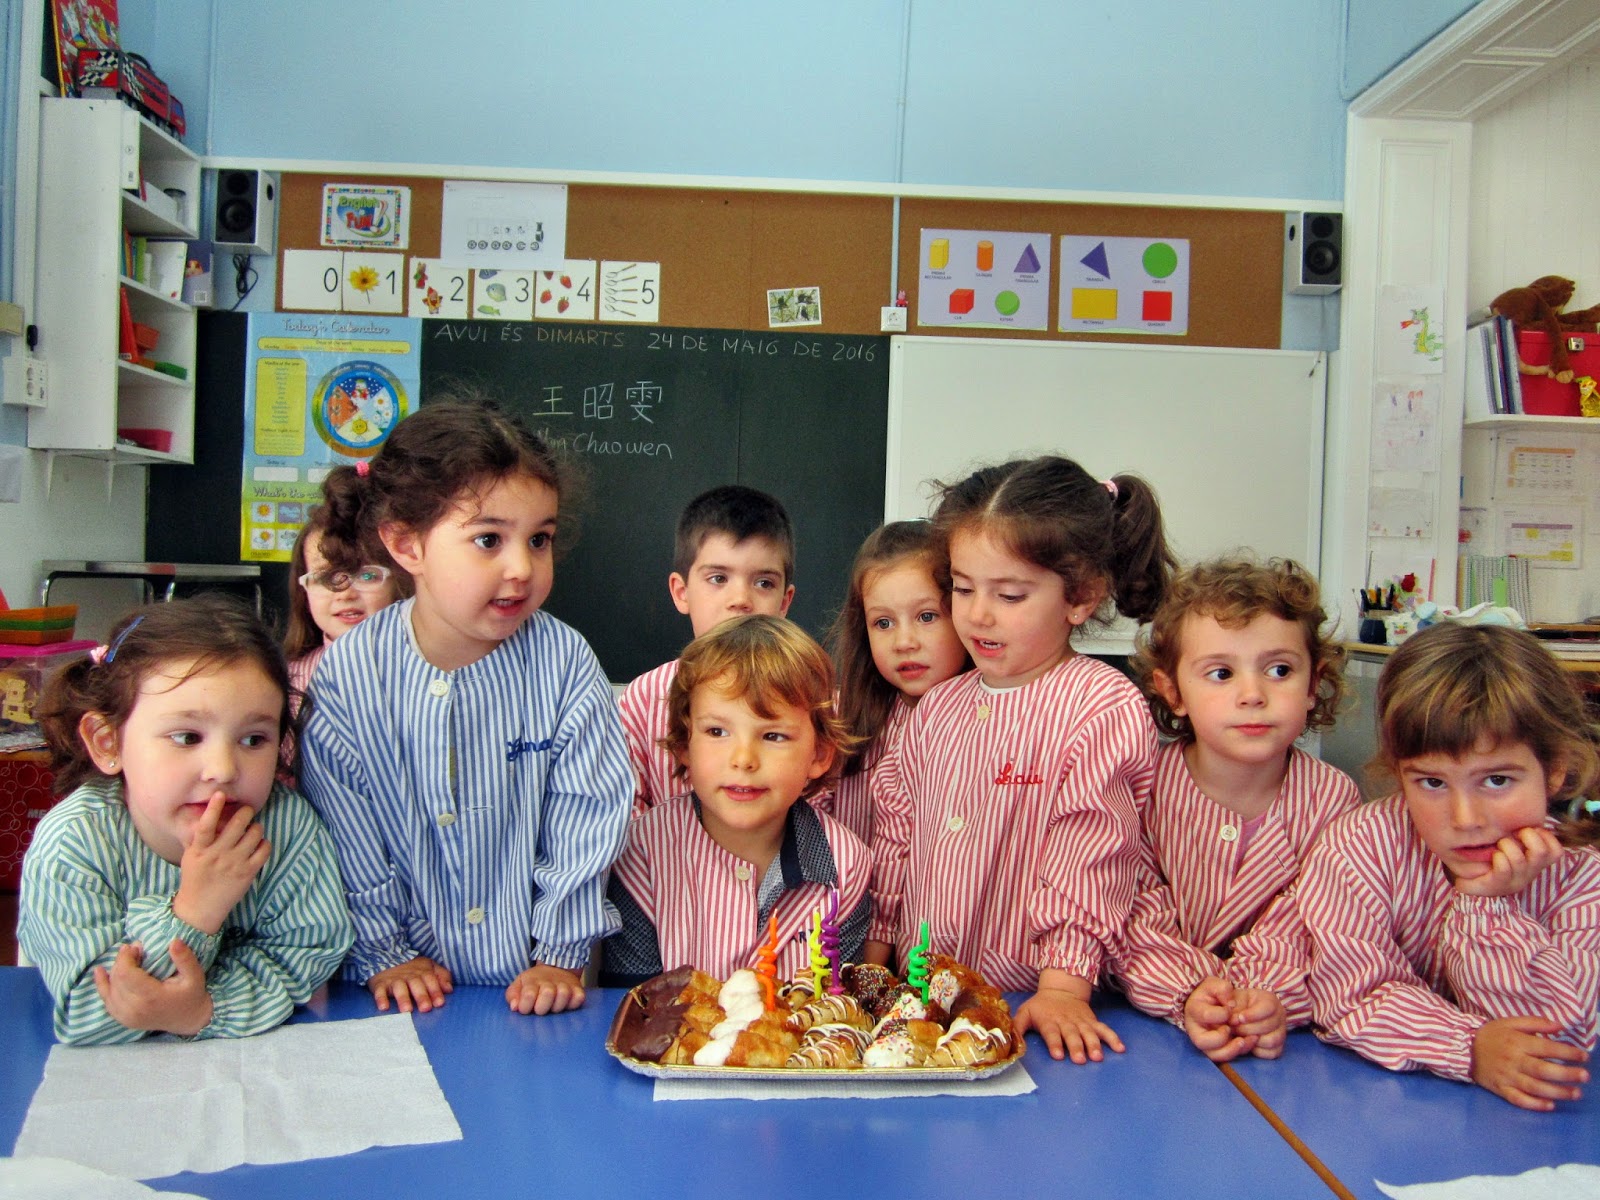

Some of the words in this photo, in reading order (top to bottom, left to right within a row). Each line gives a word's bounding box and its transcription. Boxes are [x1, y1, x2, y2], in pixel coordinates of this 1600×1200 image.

[338, 195, 380, 211] English
[323, 267, 339, 293] 0
[385, 270, 396, 295] 1
[450, 276, 465, 302] 2
[514, 277, 530, 303] 3
[576, 276, 591, 302] 4
[641, 279, 656, 305] 5
[435, 324, 487, 343] AVUI
[500, 323, 523, 342] ÉS
[537, 327, 625, 347] DIMARTS
[647, 332, 673, 350] 24
[682, 334, 709, 352] DE
[793, 341, 823, 358] DE
[832, 343, 878, 362] 2016
[573, 432, 673, 460] Chaowen
